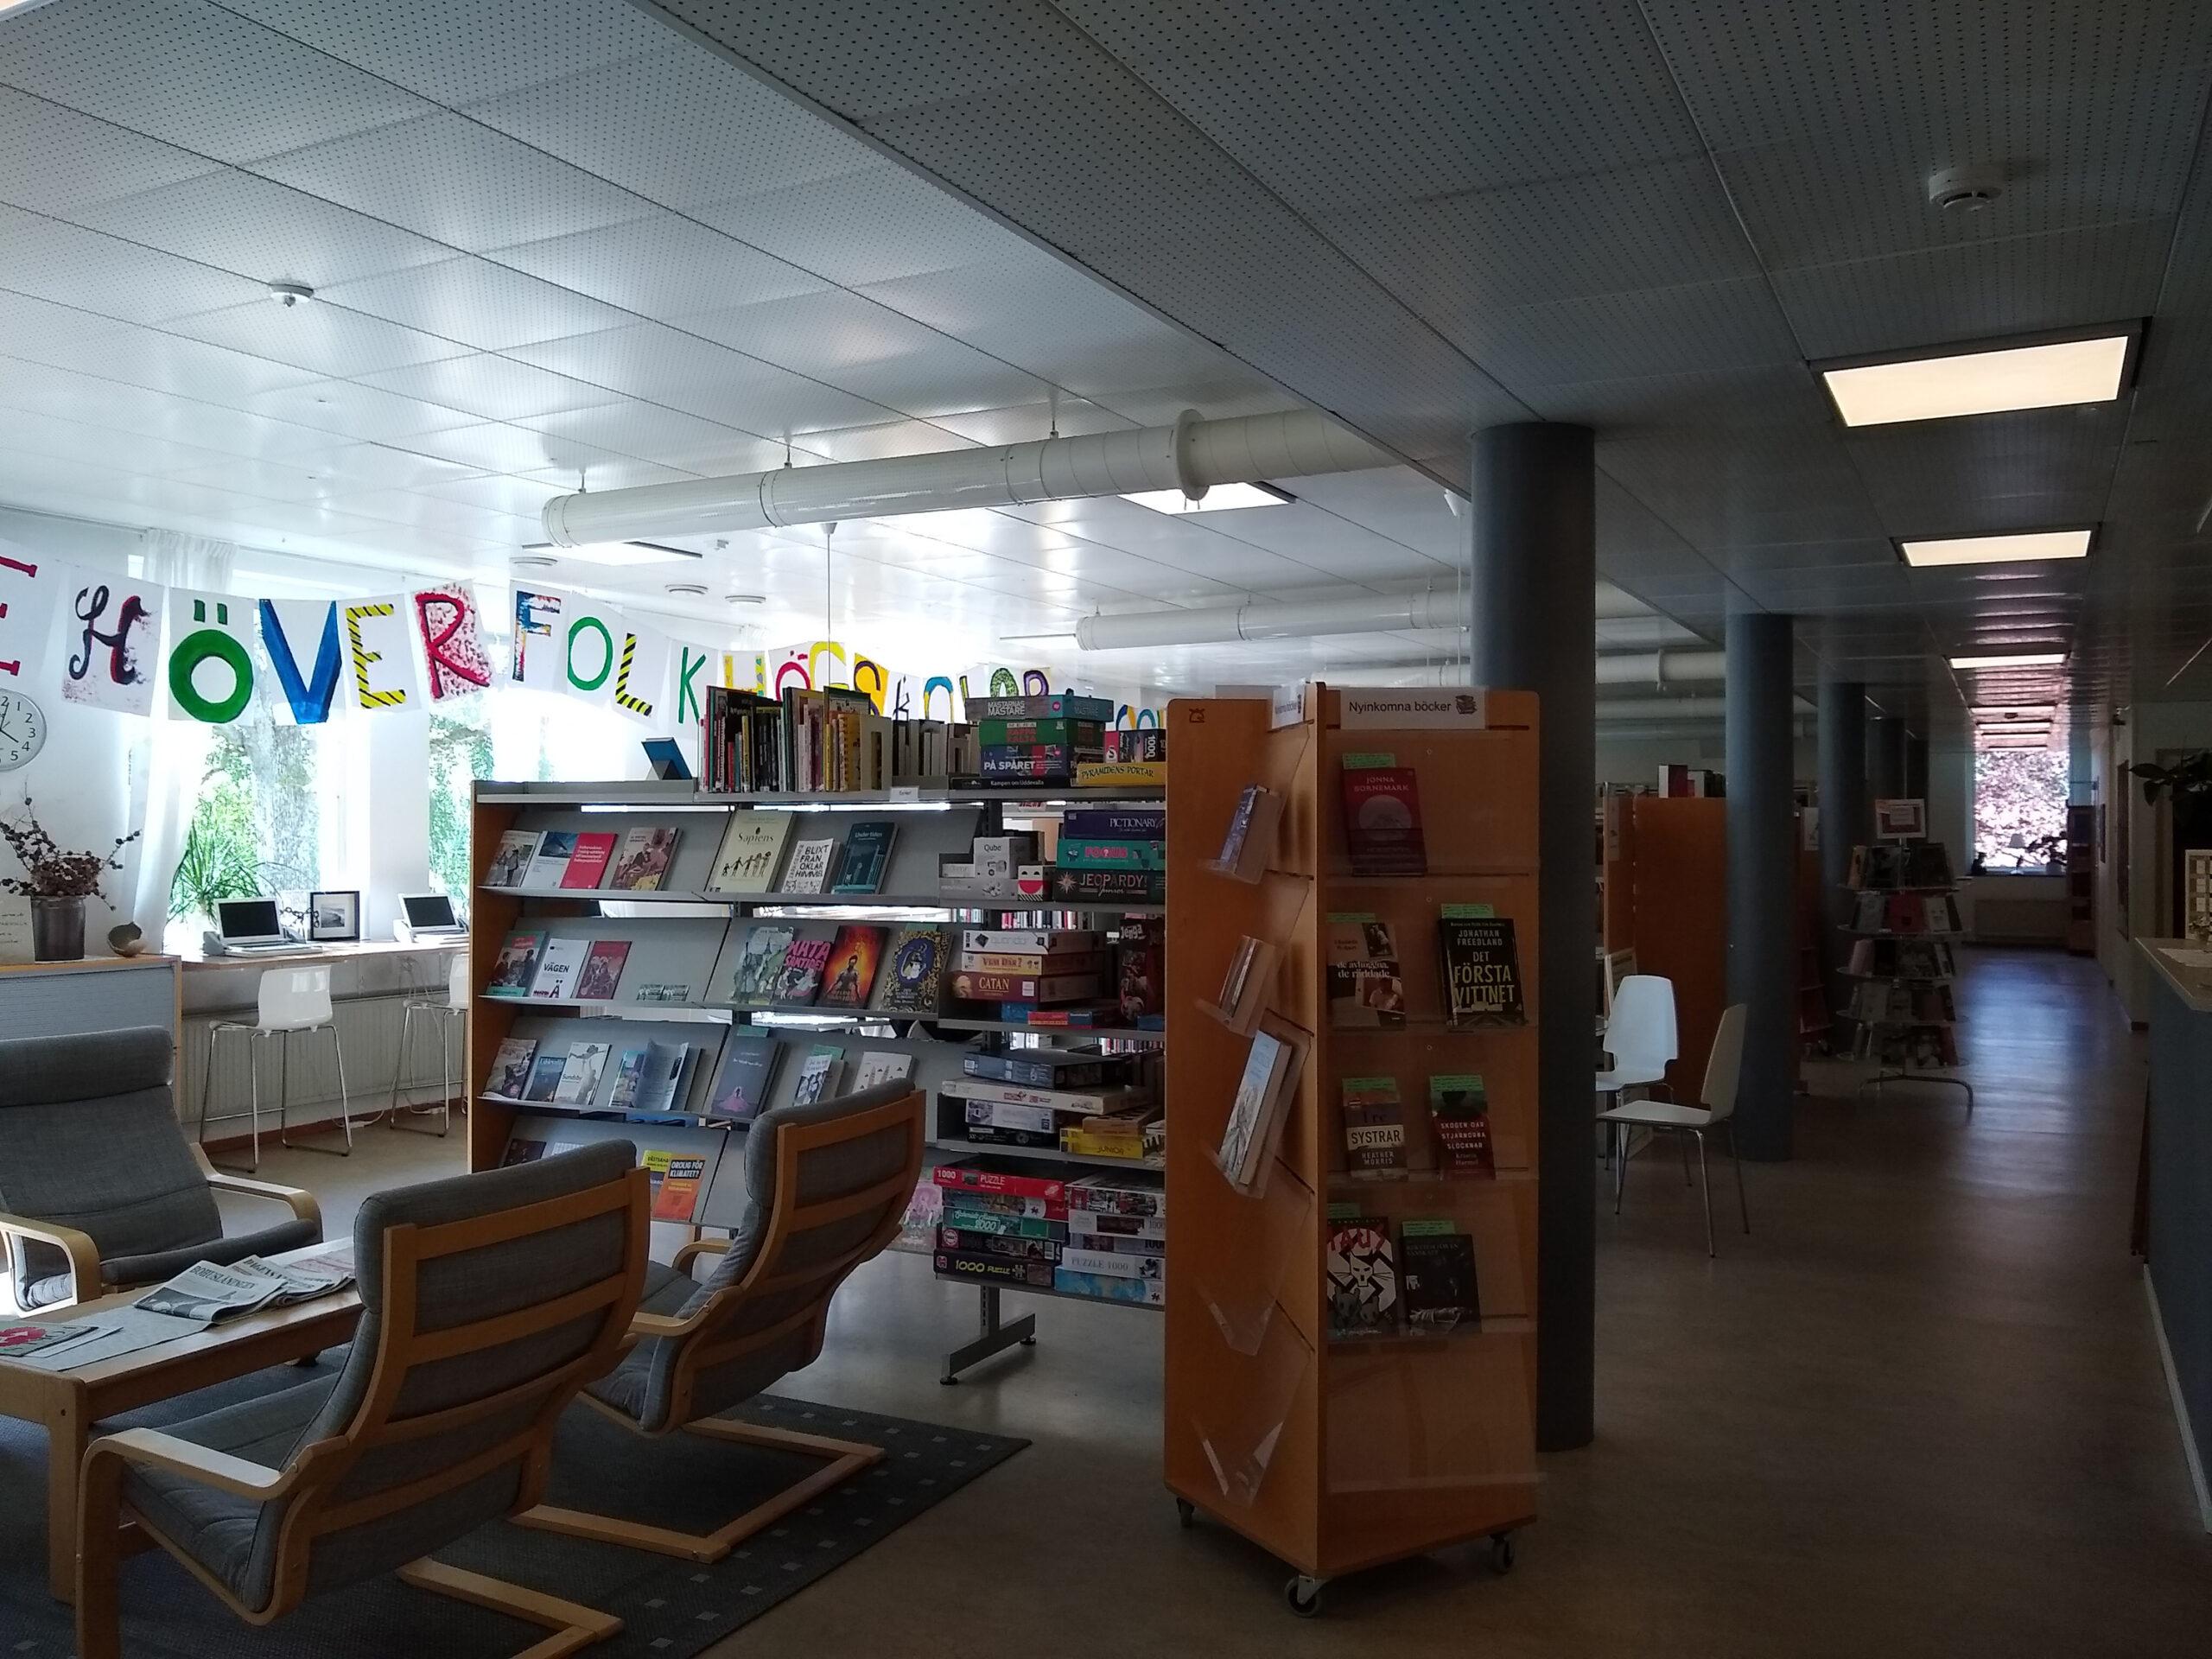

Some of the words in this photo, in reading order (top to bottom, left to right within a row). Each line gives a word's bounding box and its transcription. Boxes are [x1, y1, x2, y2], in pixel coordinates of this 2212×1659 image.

[1349, 701, 1412, 713] Nyinkomna
[1414, 700, 1452, 712] böcker
[25, 713, 33, 723] 2
[28, 727, 36, 738] 3
[22, 741, 30, 752] 4
[10, 750, 18, 760] 5
[983, 760, 996, 770] PÅ
[998, 760, 1035, 770] SPÅRET
[1354, 784, 1409, 792] BORNEMARK
[1109, 817, 1156, 828] PICTIONARY
[739, 832, 774, 845] Sapiens
[804, 843, 830, 855] BLIXT
[984, 844, 1002, 853] Qube
[799, 861, 824, 870] OKLAR
[1080, 873, 1147, 887] JEOPARDY!
[1472, 950, 1490, 963] DET
[543, 962, 569, 973] VÄGEN
[1453, 963, 1512, 984] FÖRSTA
[979, 976, 1009, 990] CATAN
[1454, 984, 1515, 1005] VITTNET
[1351, 1129, 1402, 1144] SYSTRAR
[671, 1160, 691, 1169] OROLIG
[670, 1169, 700, 1178] KLIMATET?
[937, 1170, 957, 1180] 1000
[980, 1174, 1006, 1186] PUZZLE
[955, 1260, 985, 1273] 1000
[1071, 1257, 1103, 1268] PUZZLE
[1108, 1260, 1128, 1270] 1000
